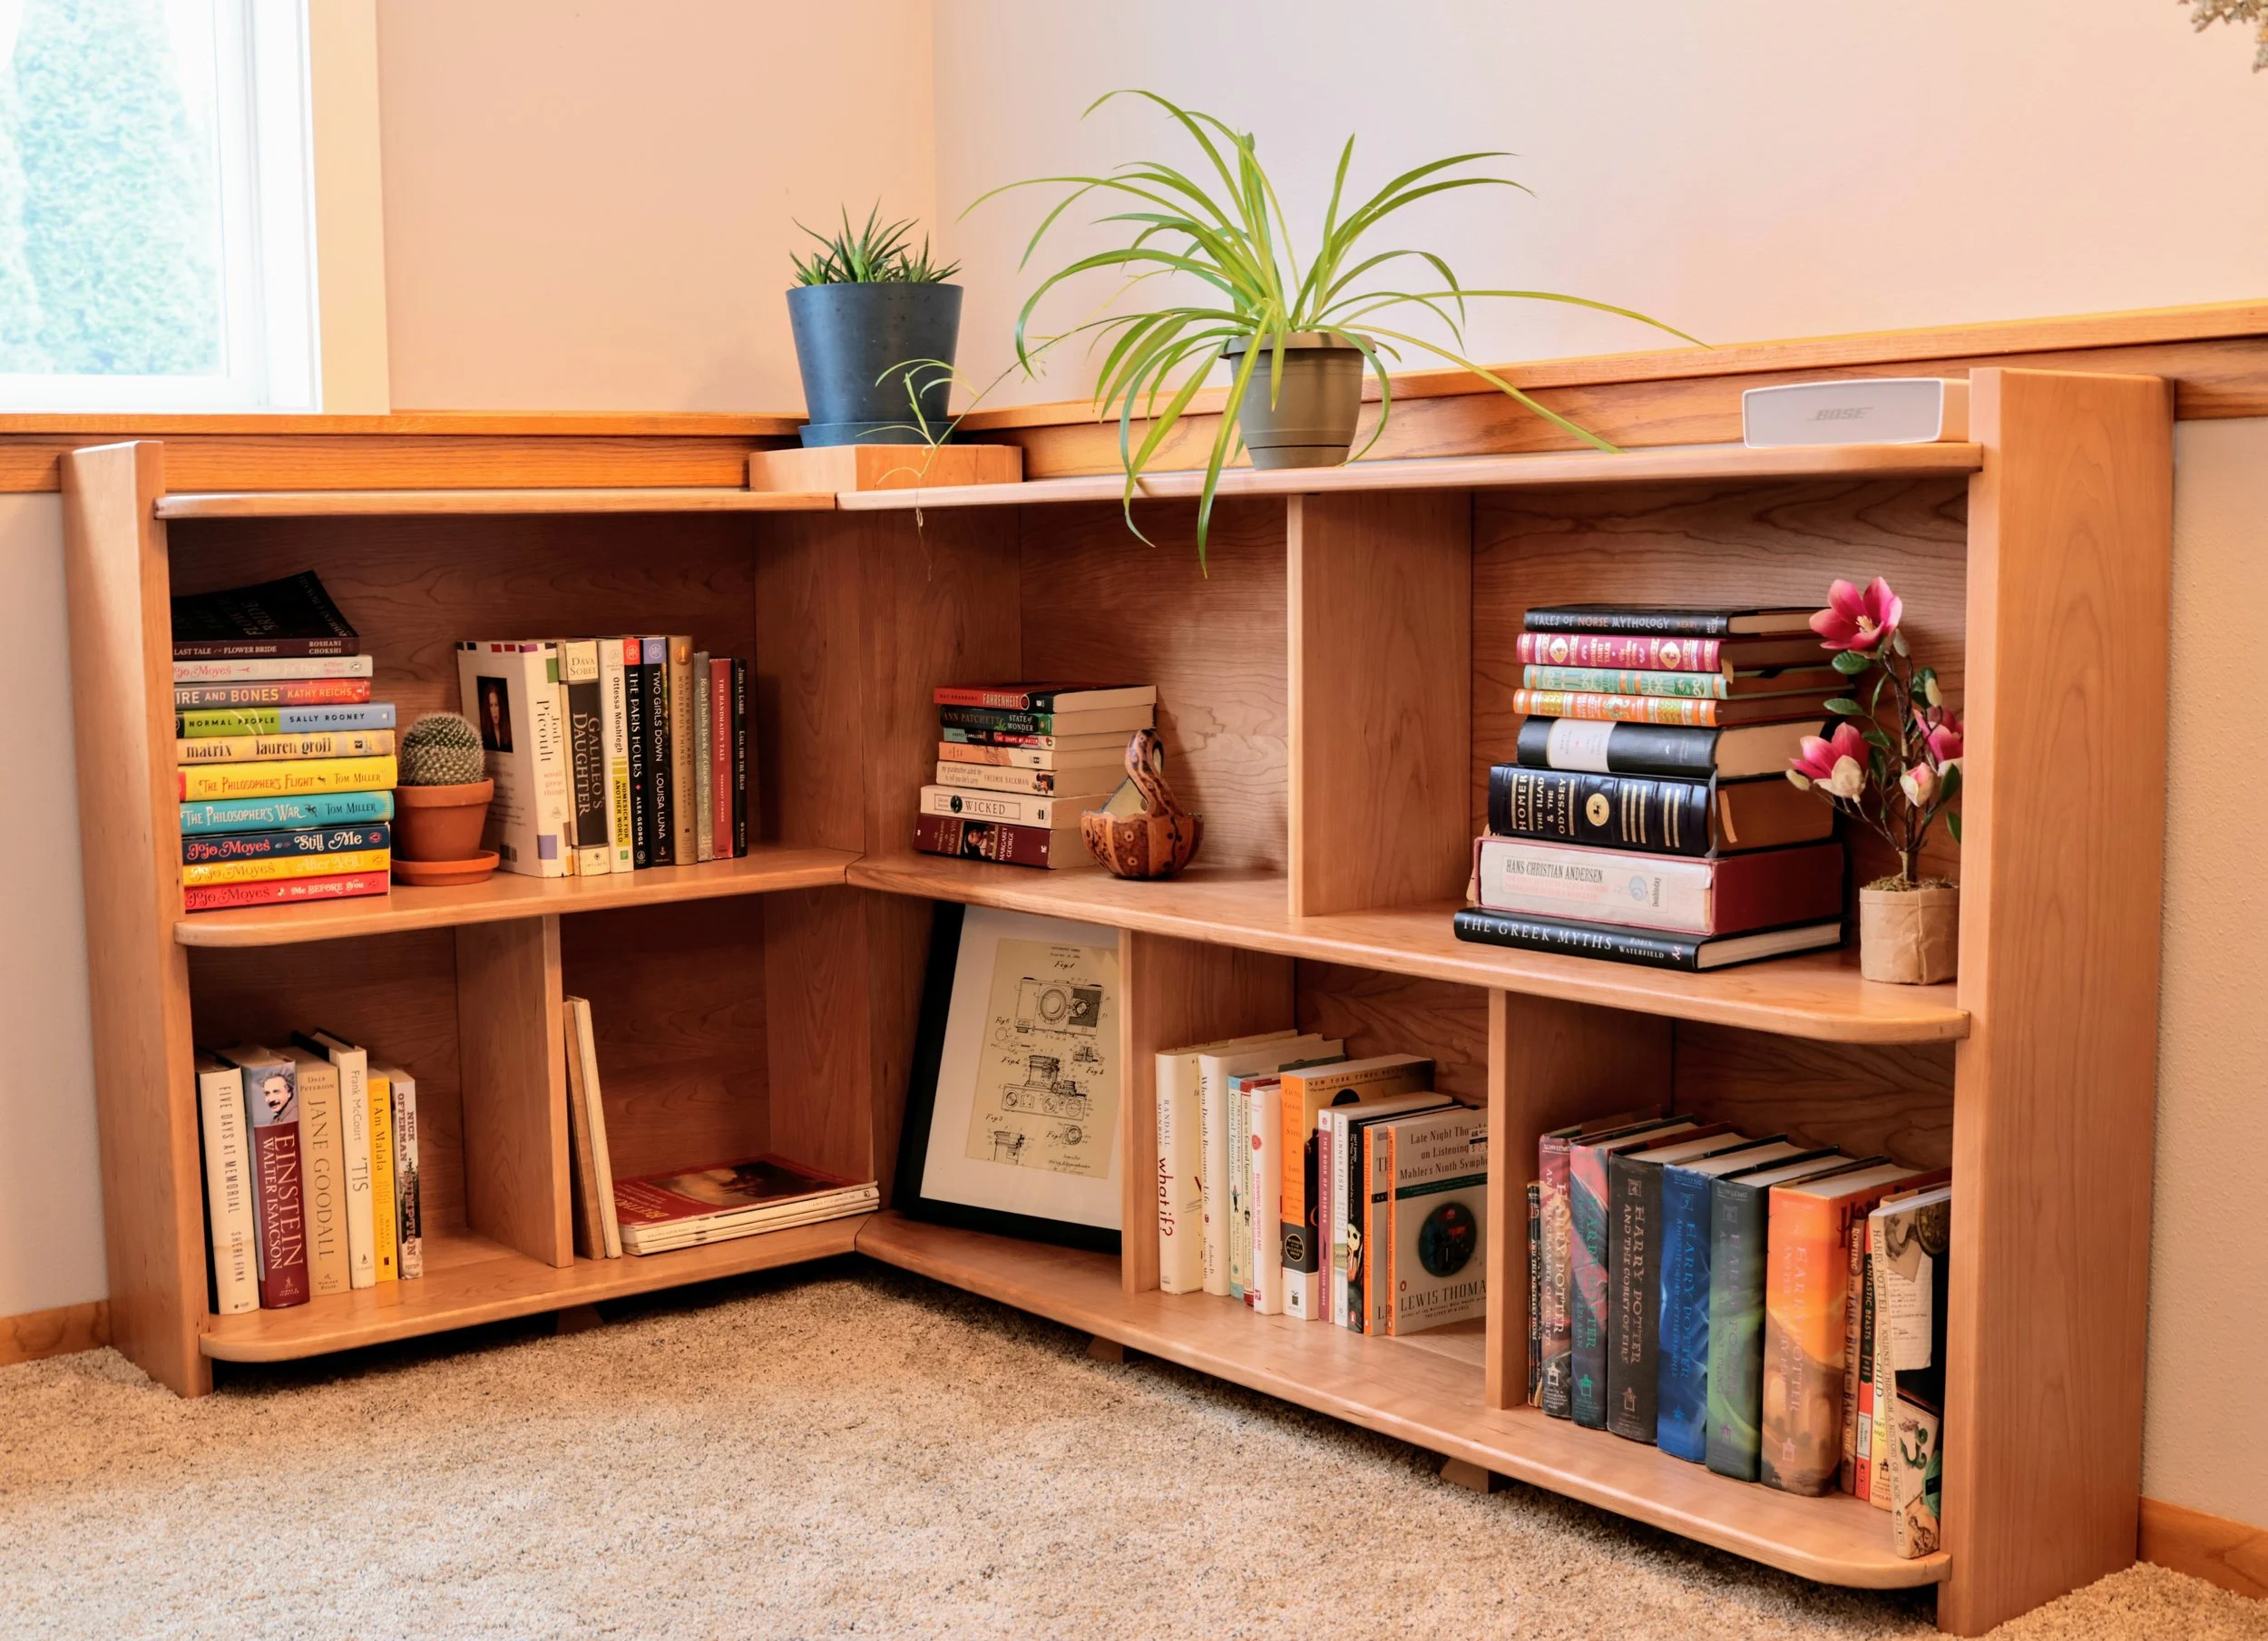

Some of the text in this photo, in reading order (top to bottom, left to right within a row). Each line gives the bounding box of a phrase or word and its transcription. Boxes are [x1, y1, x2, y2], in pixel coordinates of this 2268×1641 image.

[1805, 407, 1874, 421] BOSE
[1532, 614, 1560, 627] TALES
[1562, 615, 1576, 626] OF
[1577, 615, 1608, 628] NORSE
[1611, 616, 1670, 630] MYTHOLOGY
[223, 646, 254, 654] FLOWER
[255, 645, 278, 653] BRIDE
[571, 657, 597, 668] DAVA
[204, 688, 279, 703] AND BONES
[287, 687, 353, 698] KATHY REICHS
[982, 693, 1020, 709] FAHRENHEIT
[188, 717, 276, 728] NORMAL PEOPLE
[288, 712, 366, 724] SALLY ROONEY
[536, 699, 553, 763] Picoult
[552, 715, 562, 744] Jodi
[613, 677, 623, 754] Ottessa Moshfegh
[629, 671, 642, 778] THE PARIS HOURS
[943, 711, 959, 721] ANN
[1007, 722, 1034, 732] WONDER
[1008, 713, 1032, 723] STATE of
[186, 739, 298, 758] matrix lauren
[587, 717, 606, 810] GALILEO'S
[652, 671, 667, 840] TWO GIRLS DOWN LOUISA LUNA
[572, 712, 591, 817] DAUGHTER
[1518, 774, 1528, 831] HOMER
[1537, 776, 1545, 808] ILIAD
[1547, 789, 1555, 823] & THE
[1558, 777, 1567, 835] ODYSSEY
[964, 800, 1007, 816] WICKED
[186, 830, 363, 861] Jojo Moyes Still Me
[999, 826, 1008, 862] MARGARET
[1005, 832, 1015, 858] GEORGE
[222, 862, 276, 879] Moyes
[1505, 858, 1604, 884] HANS CHRISTIAN ANDERSEN
[184, 886, 271, 908] Jojo Moyes
[1651, 876, 1661, 908] Doubleday
[1461, 915, 1613, 951] THE GREEK MYTHS
[1628, 936, 1654, 948] ROBIN
[1618, 945, 1665, 960] WATERFIELD
[299, 1083, 335, 1092] PETERSON
[1308, 1070, 1378, 1088] NEW YORK TIMES
[351, 1070, 363, 1142] Frank McCourt
[374, 1108, 384, 1127] Am
[308, 1099, 329, 1151] JANE
[396, 1092, 407, 1162] OFFERMAN
[406, 1110, 415, 1141] NICK
[1410, 1131, 1428, 1146] Late
[1429, 1128, 1452, 1143] Night
[218, 1085, 240, 1215] FIVE DAYS AT MEMORIAL
[375, 1130, 386, 1172] Malala
[1421, 1148, 1431, 1158] on
[1432, 1142, 1470, 1159] Listening
[1434, 1159, 1458, 1175] Ninth
[263, 1137, 283, 1270] WALTER ISAACSON
[274, 1133, 304, 1267] EINSTEIN
[313, 1157, 335, 1261] GOODALL
[1158, 1157, 1175, 1237] what if?
[1586, 1198, 1599, 1266] HARRY
[1872, 1229, 1884, 1266] HARRY
[230, 1231, 245, 1283] SHERI FINK
[1552, 1182, 1568, 1334] HARRY POTTER
[1623, 1236, 1631, 1265] THE
[1850, 1226, 1861, 1271] ROWLING
[1545, 1285, 1552, 1303] OF
[1622, 1267, 1630, 1312] GOBLET
[1629, 1204, 1645, 1364] HARRY POTTER
[1864, 1258, 1873, 1340] FANTASTIC BEASTS
[1875, 1269, 1888, 1314] POTTER
[1400, 1290, 1439, 1312] LEWIS
[1679, 1223, 1696, 1379] HARRY POTTER
[1544, 1305, 1552, 1347] SECRETS
[1622, 1314, 1629, 1332] OF
[1620, 1334, 1629, 1364] FIRE
[1881, 1329, 1893, 1368] JOURNEY
[1884, 1371, 1894, 1413] THROUGH
[1888, 1423, 1899, 1459] HISTORY
[1892, 1461, 1900, 1472] OF
[1893, 1475, 1902, 1504] MAGIC
